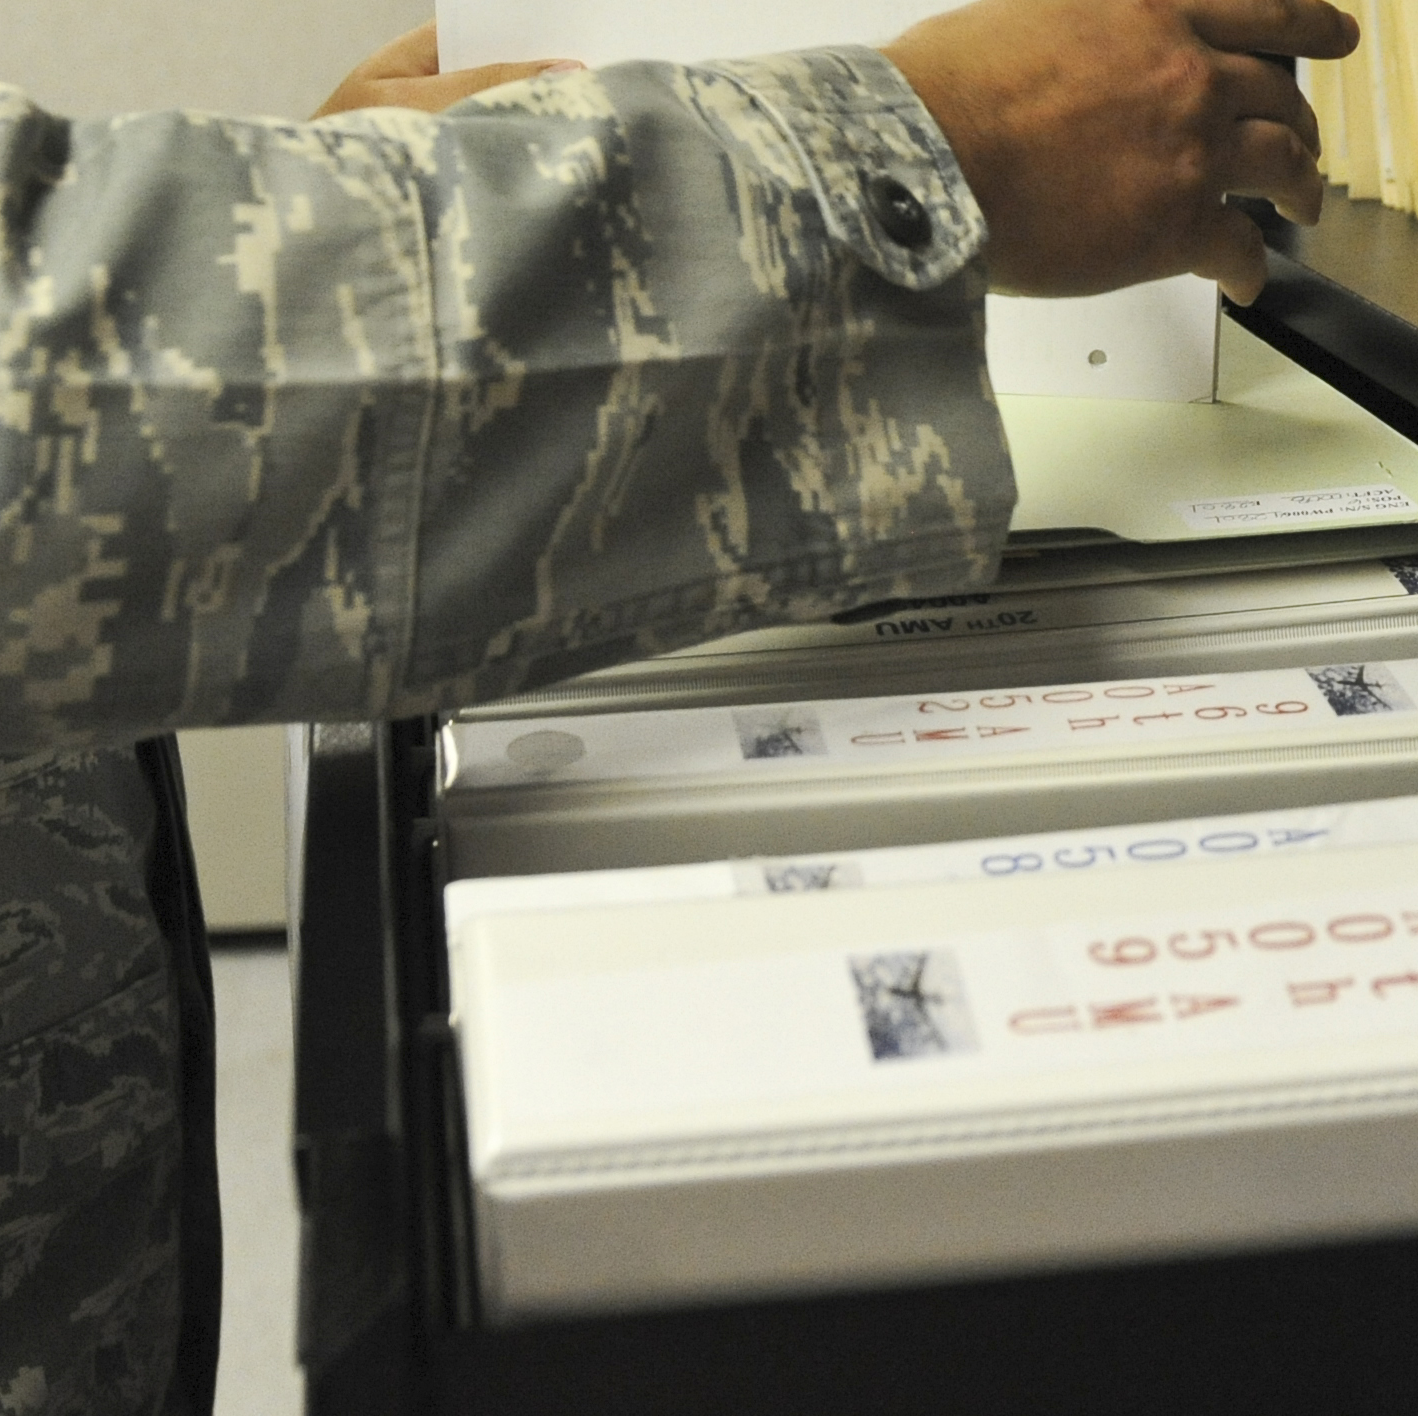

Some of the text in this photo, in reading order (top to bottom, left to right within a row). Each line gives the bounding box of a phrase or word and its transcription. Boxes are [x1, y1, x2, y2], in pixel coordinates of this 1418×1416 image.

[875, 616, 954, 636] AMU
[917, 683, 1217, 715] A0052
[850, 700, 1309, 746] 96th AMU
[981, 827, 1330, 876] A0058
[1007, 993, 1241, 1035] AMU
